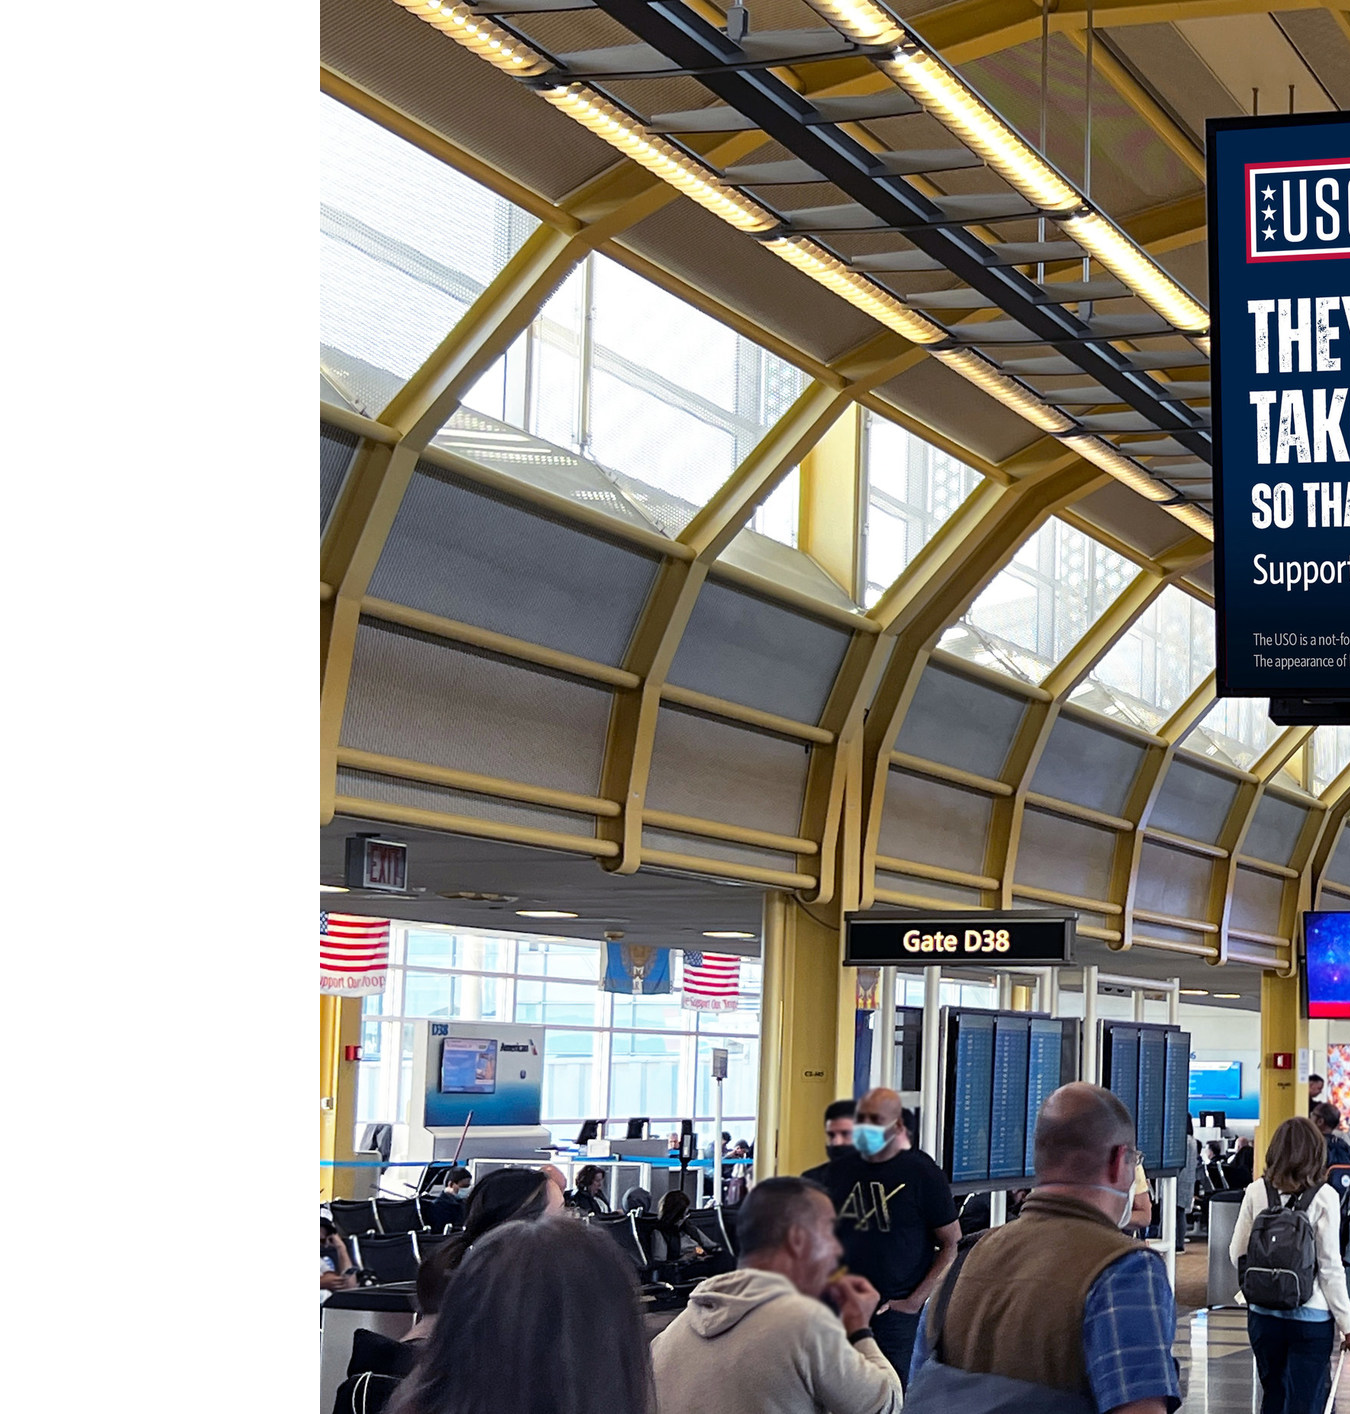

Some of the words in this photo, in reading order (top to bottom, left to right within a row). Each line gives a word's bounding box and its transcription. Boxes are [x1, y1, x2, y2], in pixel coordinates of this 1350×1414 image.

[1251, 482, 1294, 530] SO
[1252, 632, 1274, 646] The
[1274, 632, 1298, 646] USO
[1299, 633, 1308, 646] is
[1310, 636, 1317, 646] a
[1253, 654, 1274, 668] The
[1274, 657, 1335, 671] appearance
[1336, 653, 1347, 668] of
[369, 845, 404, 885] EXIT
[902, 929, 958, 953] Gate
[964, 929, 1010, 952] D38
